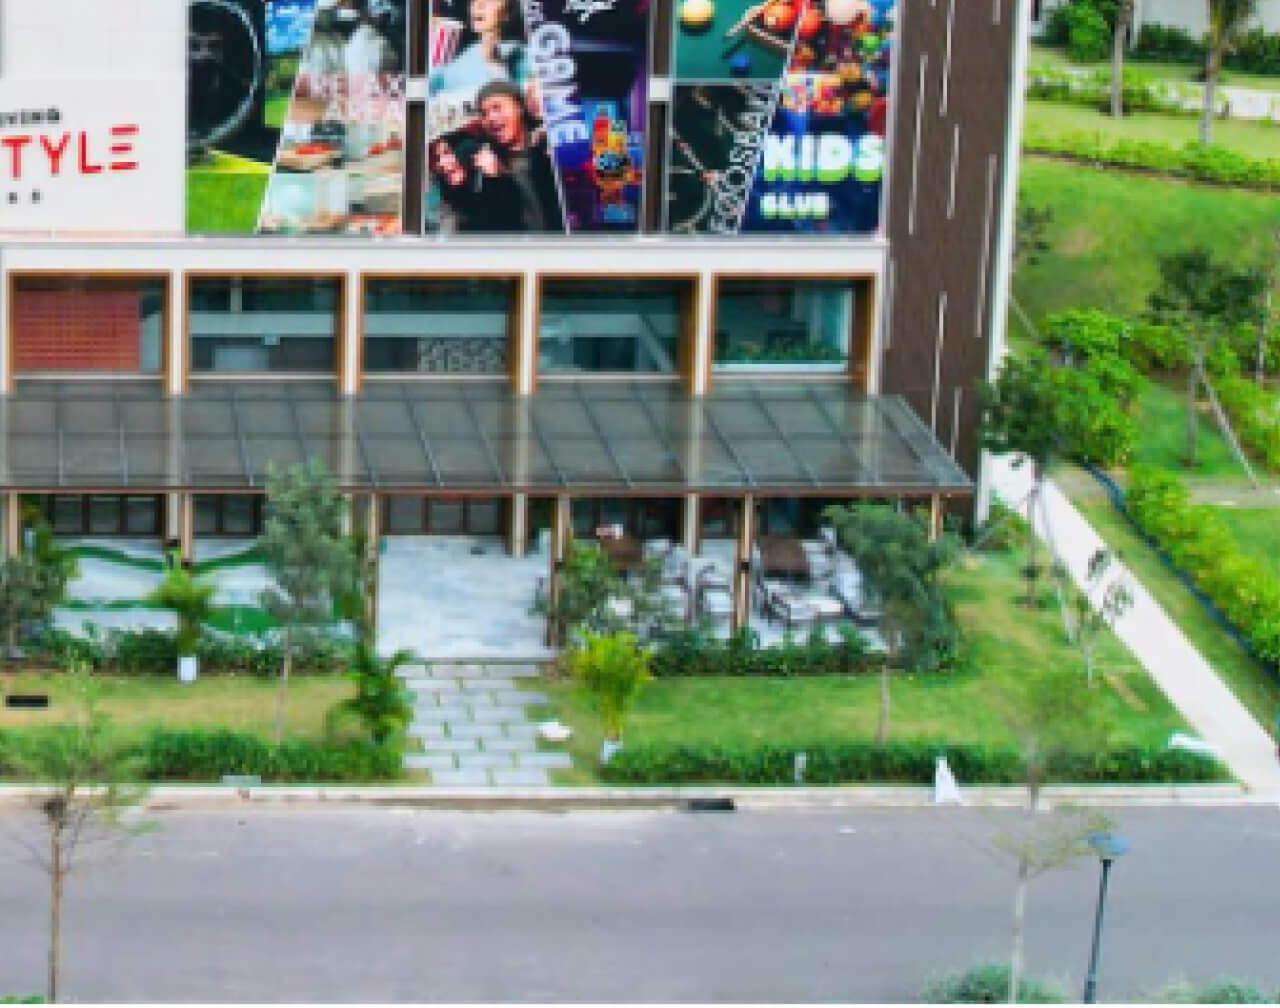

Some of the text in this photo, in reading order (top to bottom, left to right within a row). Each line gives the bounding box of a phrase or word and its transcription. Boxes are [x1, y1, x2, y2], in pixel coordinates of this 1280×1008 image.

[527, 21, 590, 143] GAME
[762, 133, 885, 182] KIDS
[760, 192, 831, 220] CLUB
